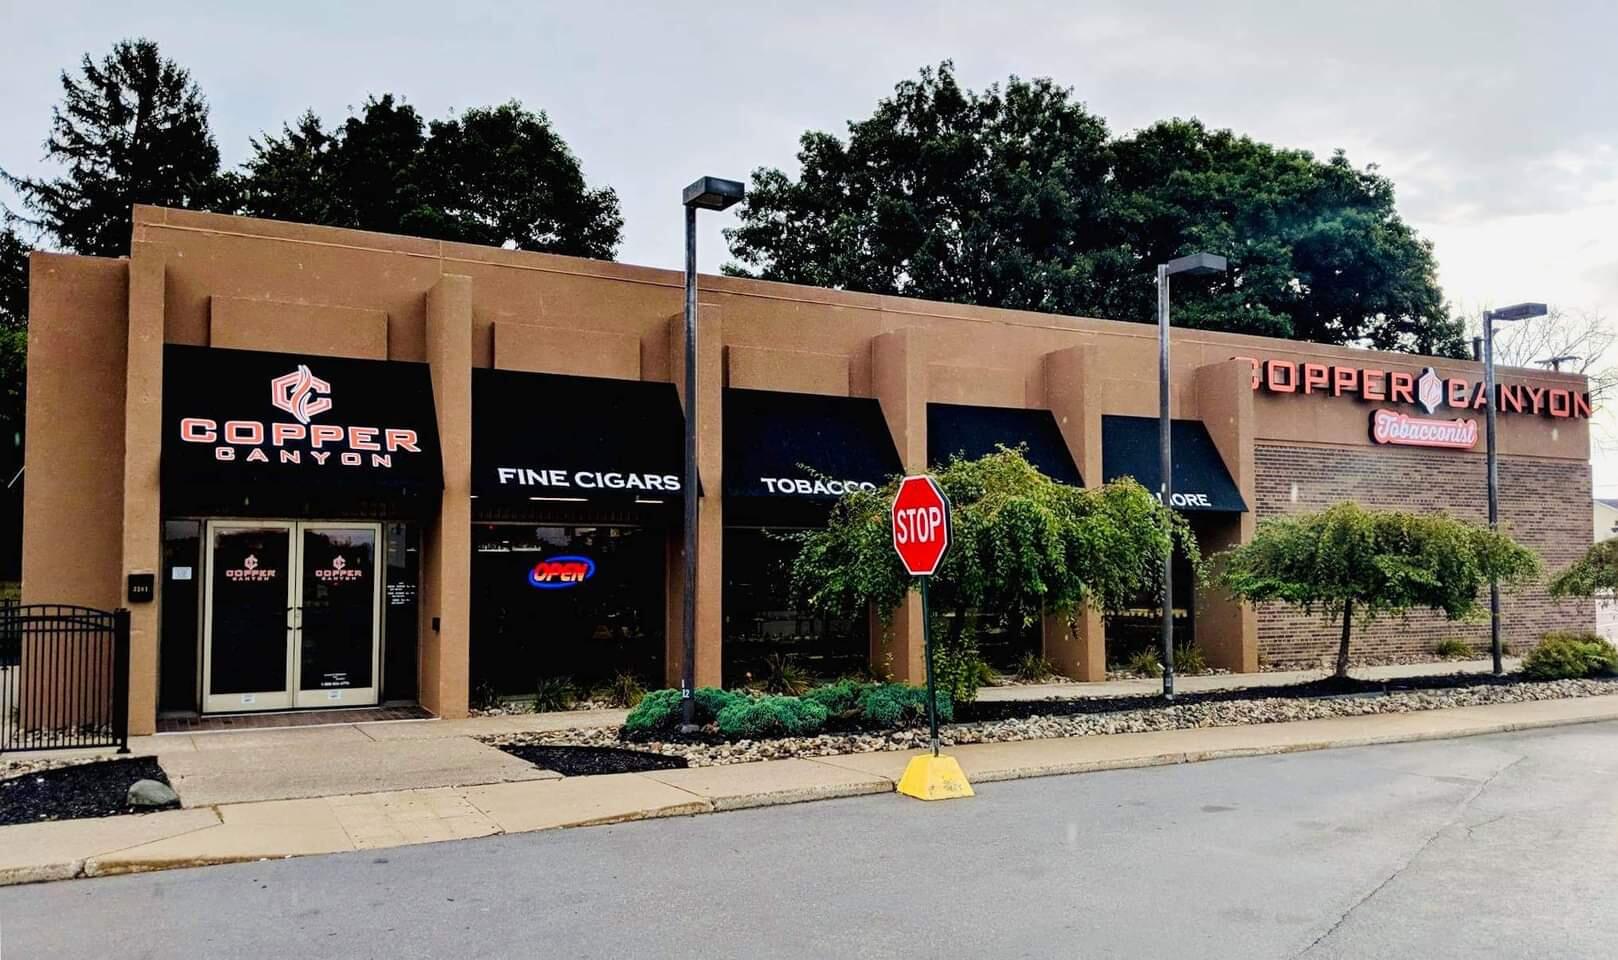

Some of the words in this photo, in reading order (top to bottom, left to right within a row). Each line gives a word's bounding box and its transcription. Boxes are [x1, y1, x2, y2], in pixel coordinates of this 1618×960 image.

[180, 417, 422, 453] COPPER
[1378, 413, 1475, 443] Tobacconist
[215, 446, 393, 468] CANYON
[498, 467, 570, 487] FINE
[574, 471, 681, 491] CIGARS
[896, 506, 942, 544] STOP
[533, 561, 589, 582] OPEN
